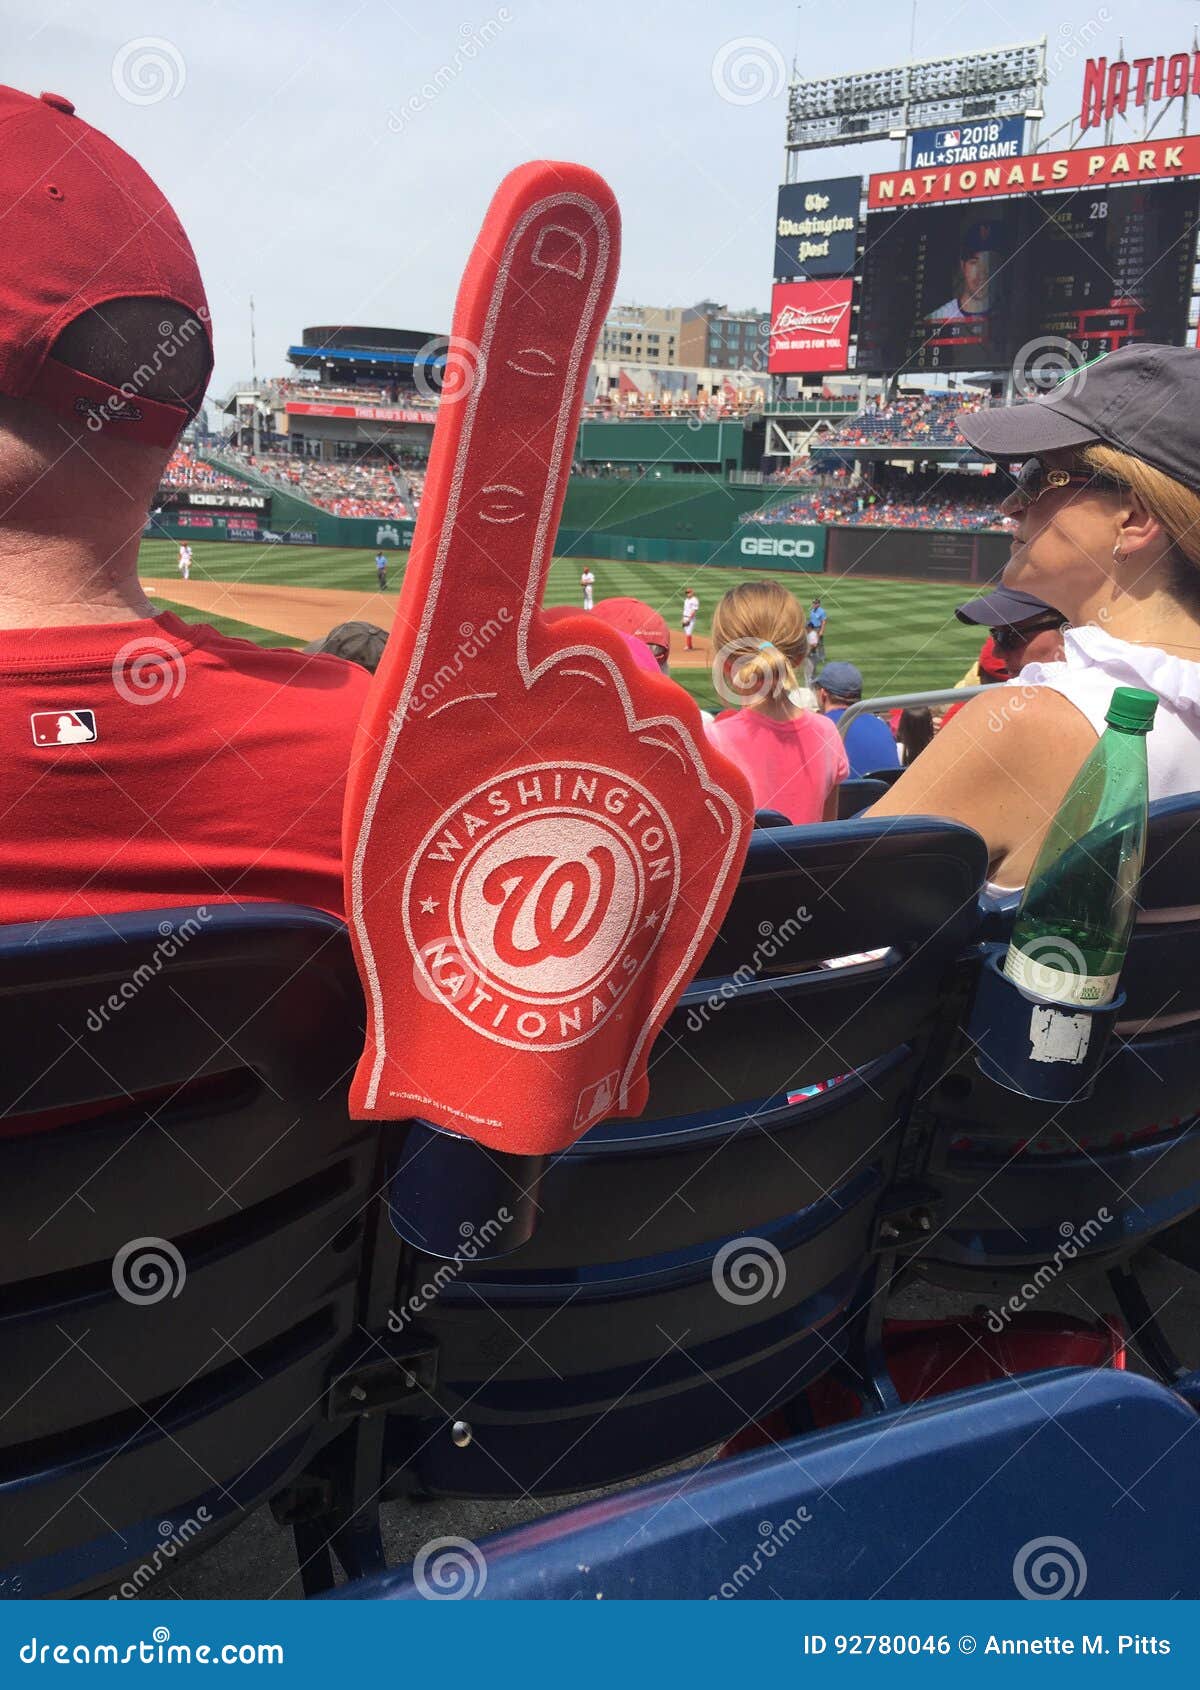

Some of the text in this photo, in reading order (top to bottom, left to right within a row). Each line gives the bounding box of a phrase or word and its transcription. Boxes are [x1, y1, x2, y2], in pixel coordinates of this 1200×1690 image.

[962, 124, 999, 145] 2018
[979, 140, 1018, 161] GAME
[878, 145, 1185, 199] NATIONALS PARK
[804, 193, 830, 212] The
[1089, 202, 1109, 219] 2B
[778, 216, 854, 238] Washington
[798, 240, 829, 263] Post
[779, 311, 840, 328] Budweiser
[812, 339, 825, 349] FOR
[229, 495, 264, 508] FAN
[740, 537, 815, 558] GEICO
[427, 774, 671, 881] WASHINGTON
[425, 942, 638, 1038] NATIONALS
